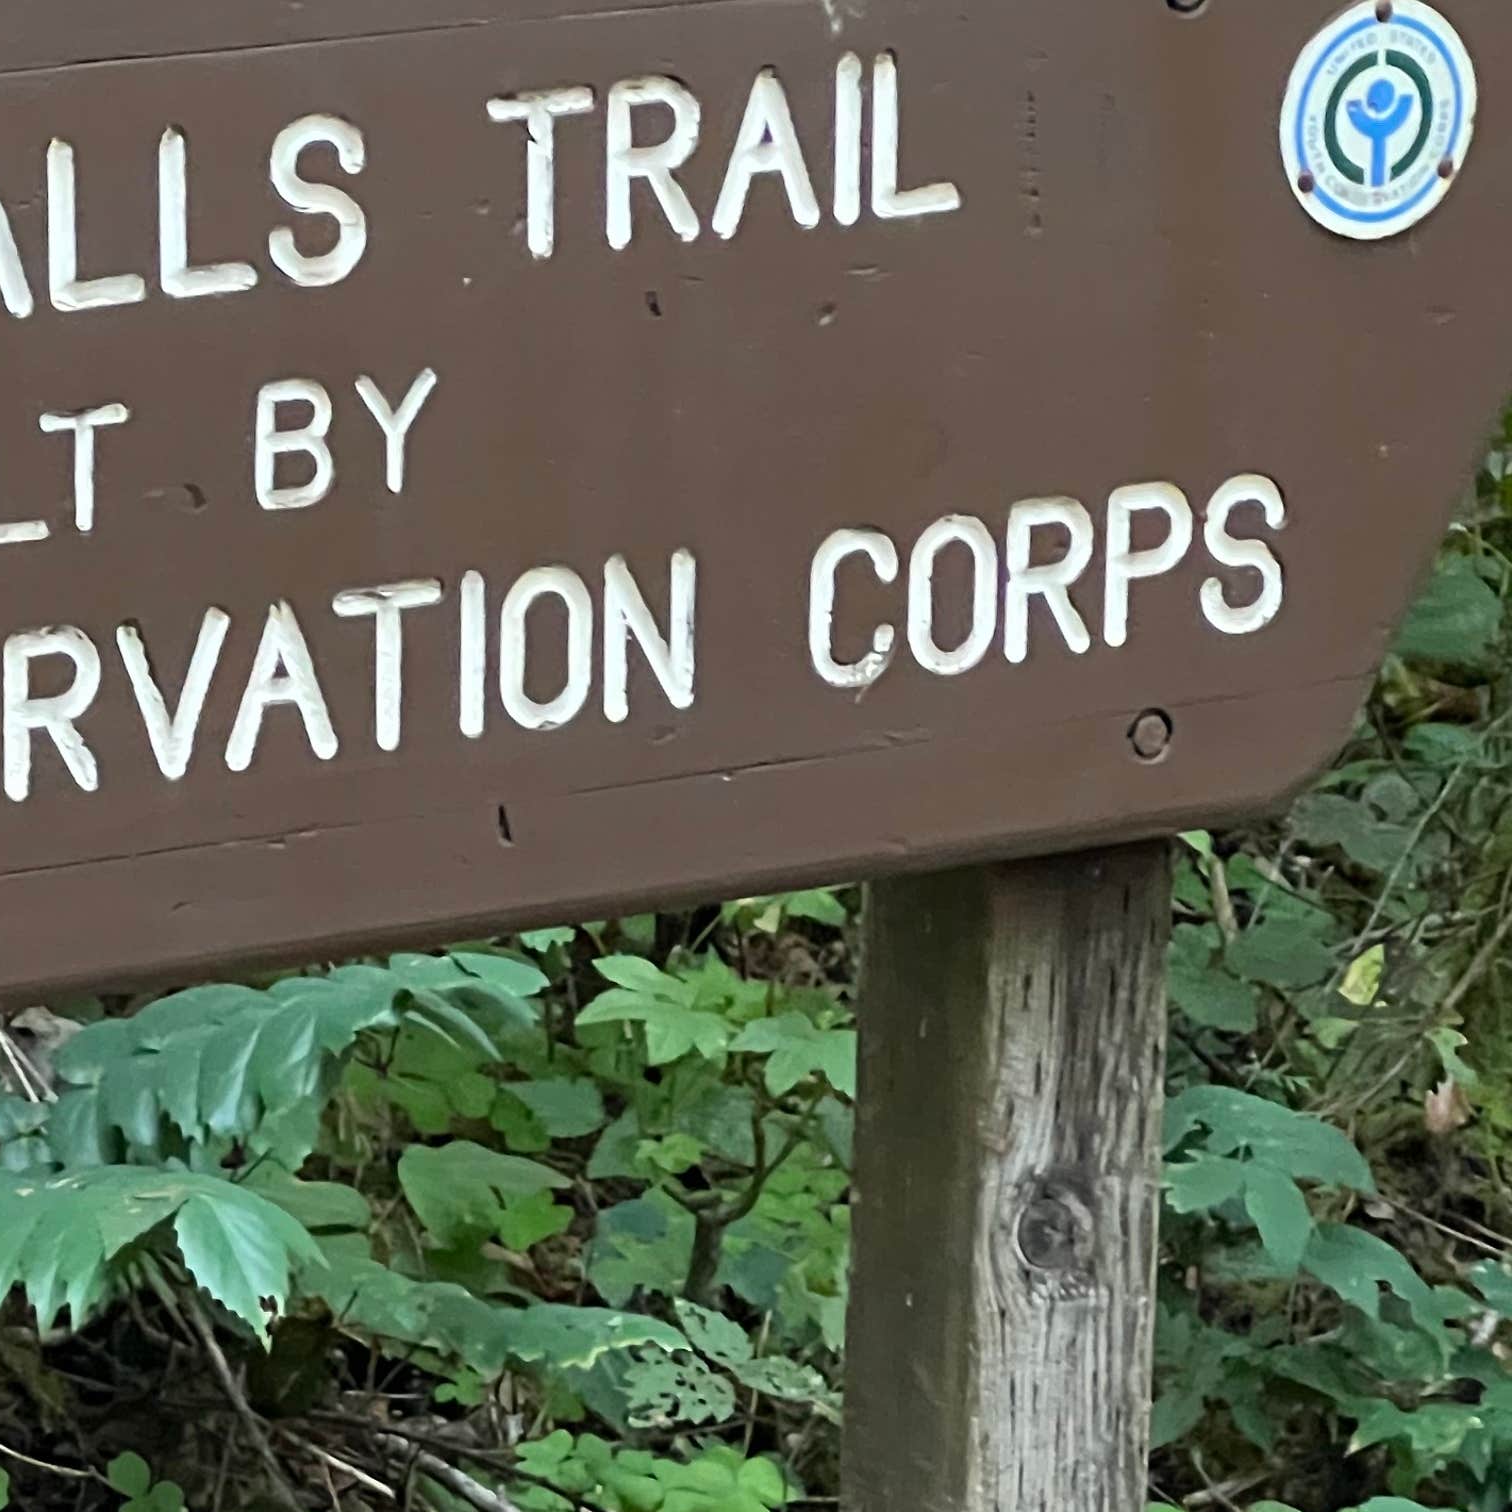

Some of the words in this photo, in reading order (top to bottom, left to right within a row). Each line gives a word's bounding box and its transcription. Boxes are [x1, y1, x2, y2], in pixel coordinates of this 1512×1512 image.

[485, 51, 962, 260] TRAIL
[253, 366, 438, 512] BY
[807, 473, 1286, 689] CORPS
